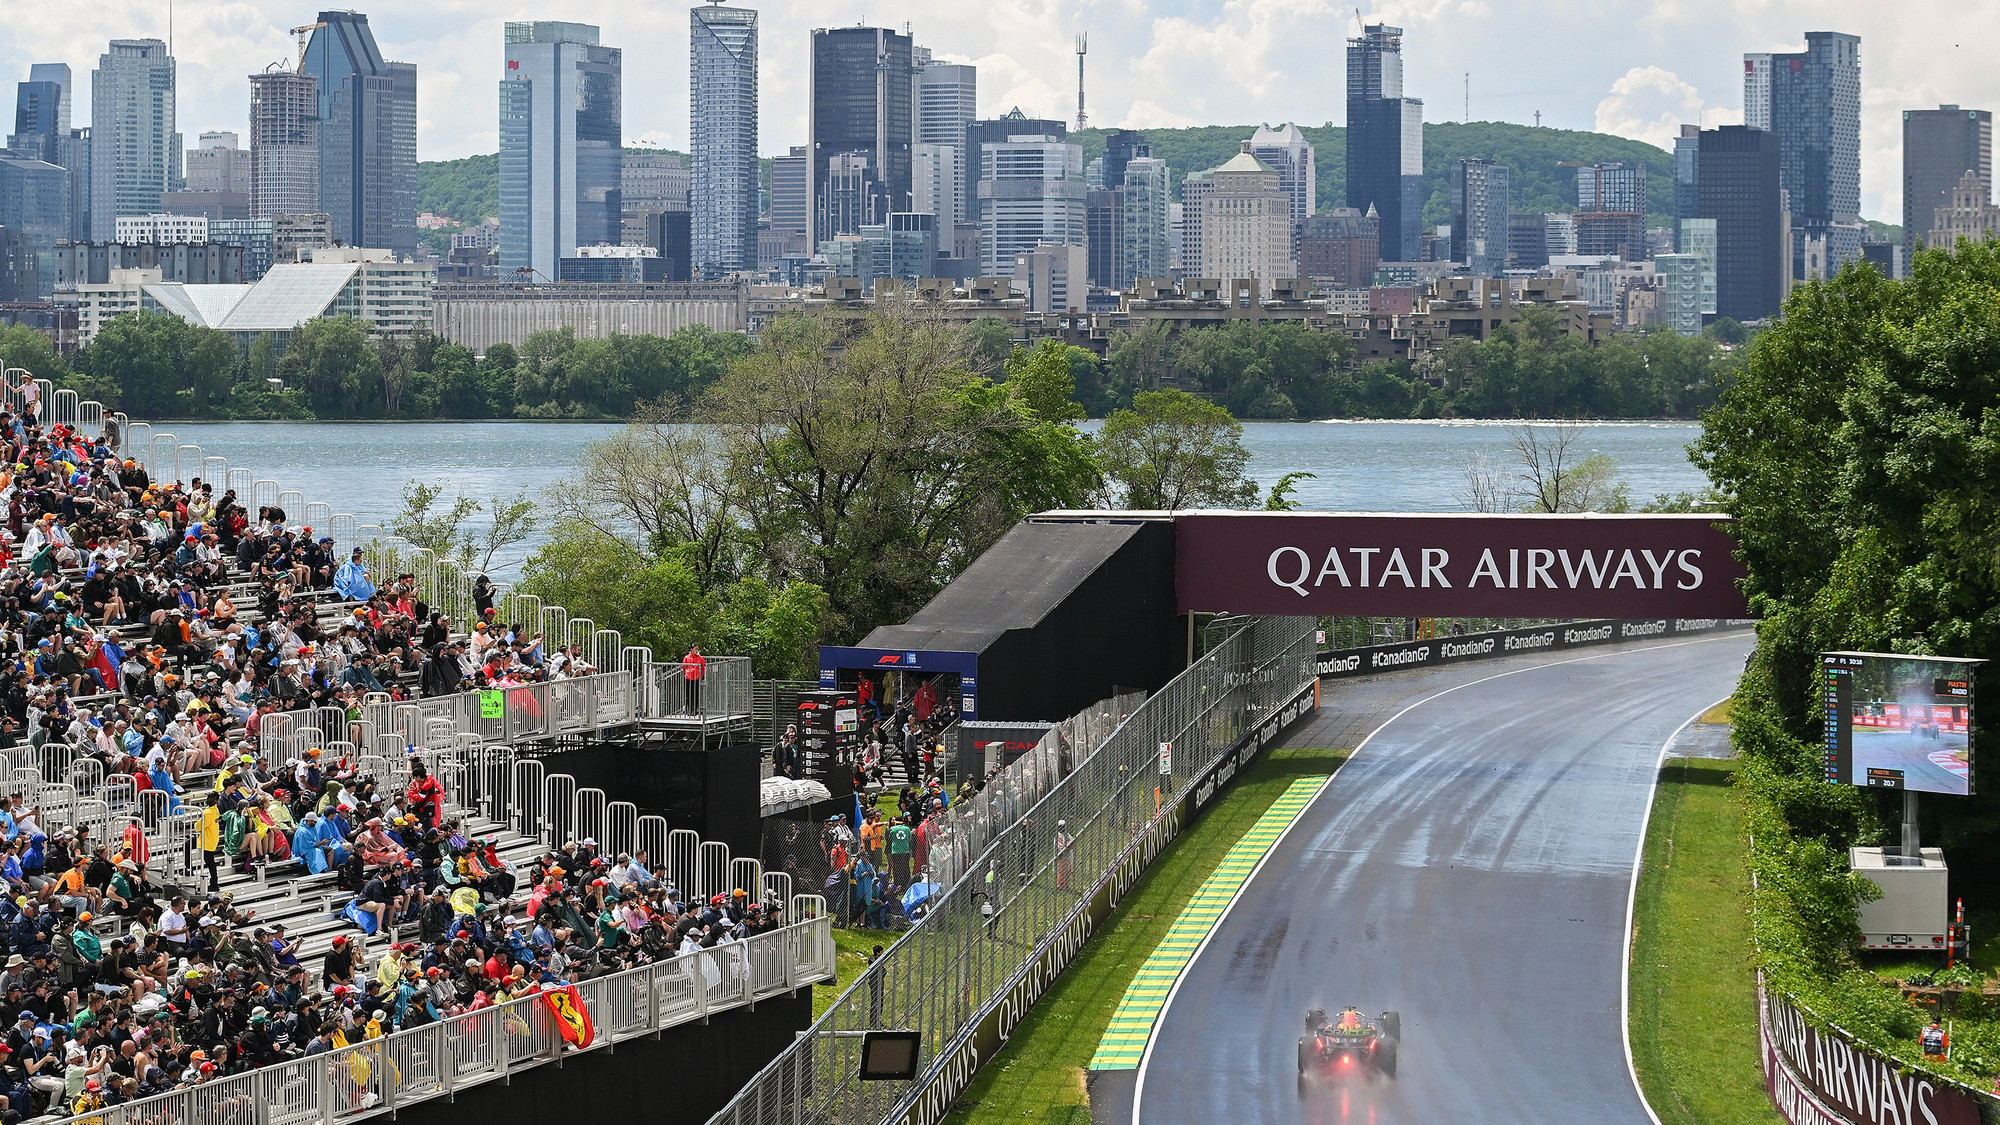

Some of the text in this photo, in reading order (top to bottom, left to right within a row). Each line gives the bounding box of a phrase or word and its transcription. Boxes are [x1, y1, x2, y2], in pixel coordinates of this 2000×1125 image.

[1267, 546, 1704, 597] QATAR AIRWAYS
[1564, 626, 1612, 643] #CanadianGP
[1621, 620, 1667, 636] #CanadianGP
[1441, 638, 1494, 657] #CanadianGP
[1504, 632, 1554, 650] #CanadianGP
[1372, 646, 1429, 667] #CanadianGP
[974, 741, 1038, 750] SCAN
[1110, 805, 1179, 911] QATAR AIRWAYS
[999, 902, 1092, 1040] QATAR AIRWAYS
[917, 1032, 978, 1125] AIRWAYS
